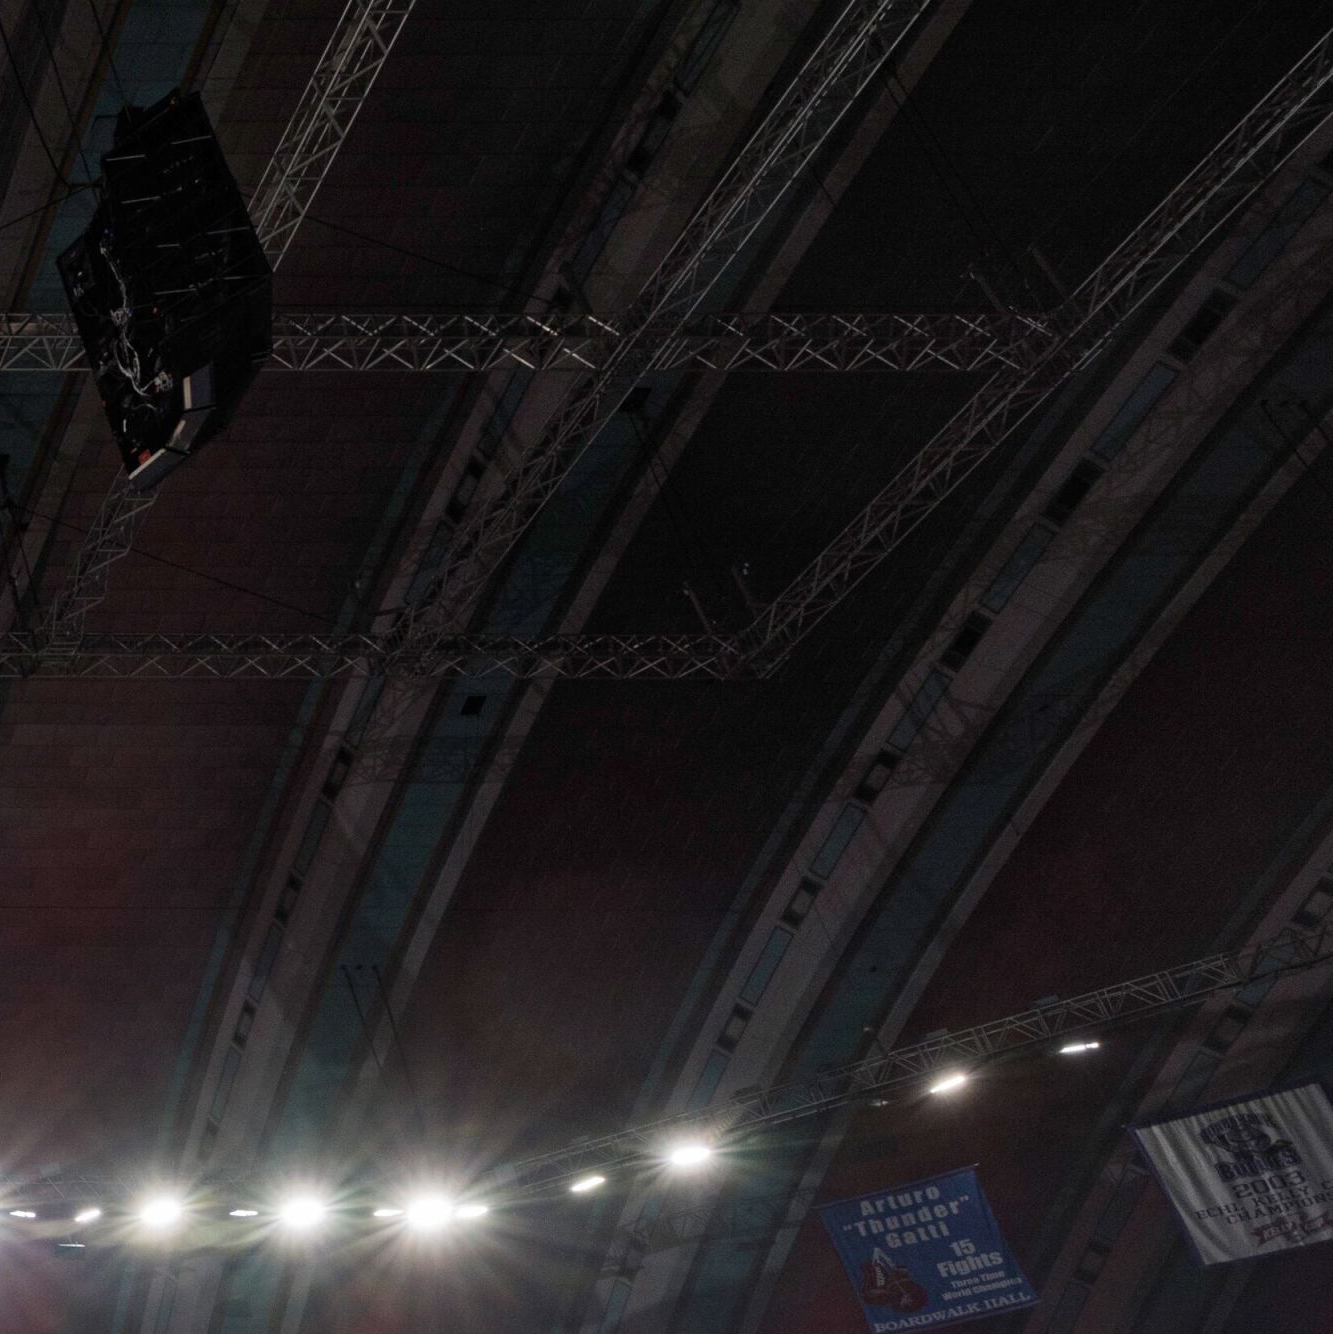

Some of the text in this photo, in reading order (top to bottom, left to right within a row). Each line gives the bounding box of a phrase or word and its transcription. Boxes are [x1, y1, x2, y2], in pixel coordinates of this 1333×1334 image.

[1232, 1170, 1305, 1199] 2003
[1252, 1185, 1311, 1208] KELLY
[860, 1185, 942, 1217] Arturo
[885, 1221, 950, 1249] Gatti
[949, 1238, 977, 1257] 15
[936, 1250, 1004, 1279] Fights
[873, 1291, 1032, 1334] BOARDWALK HALL
